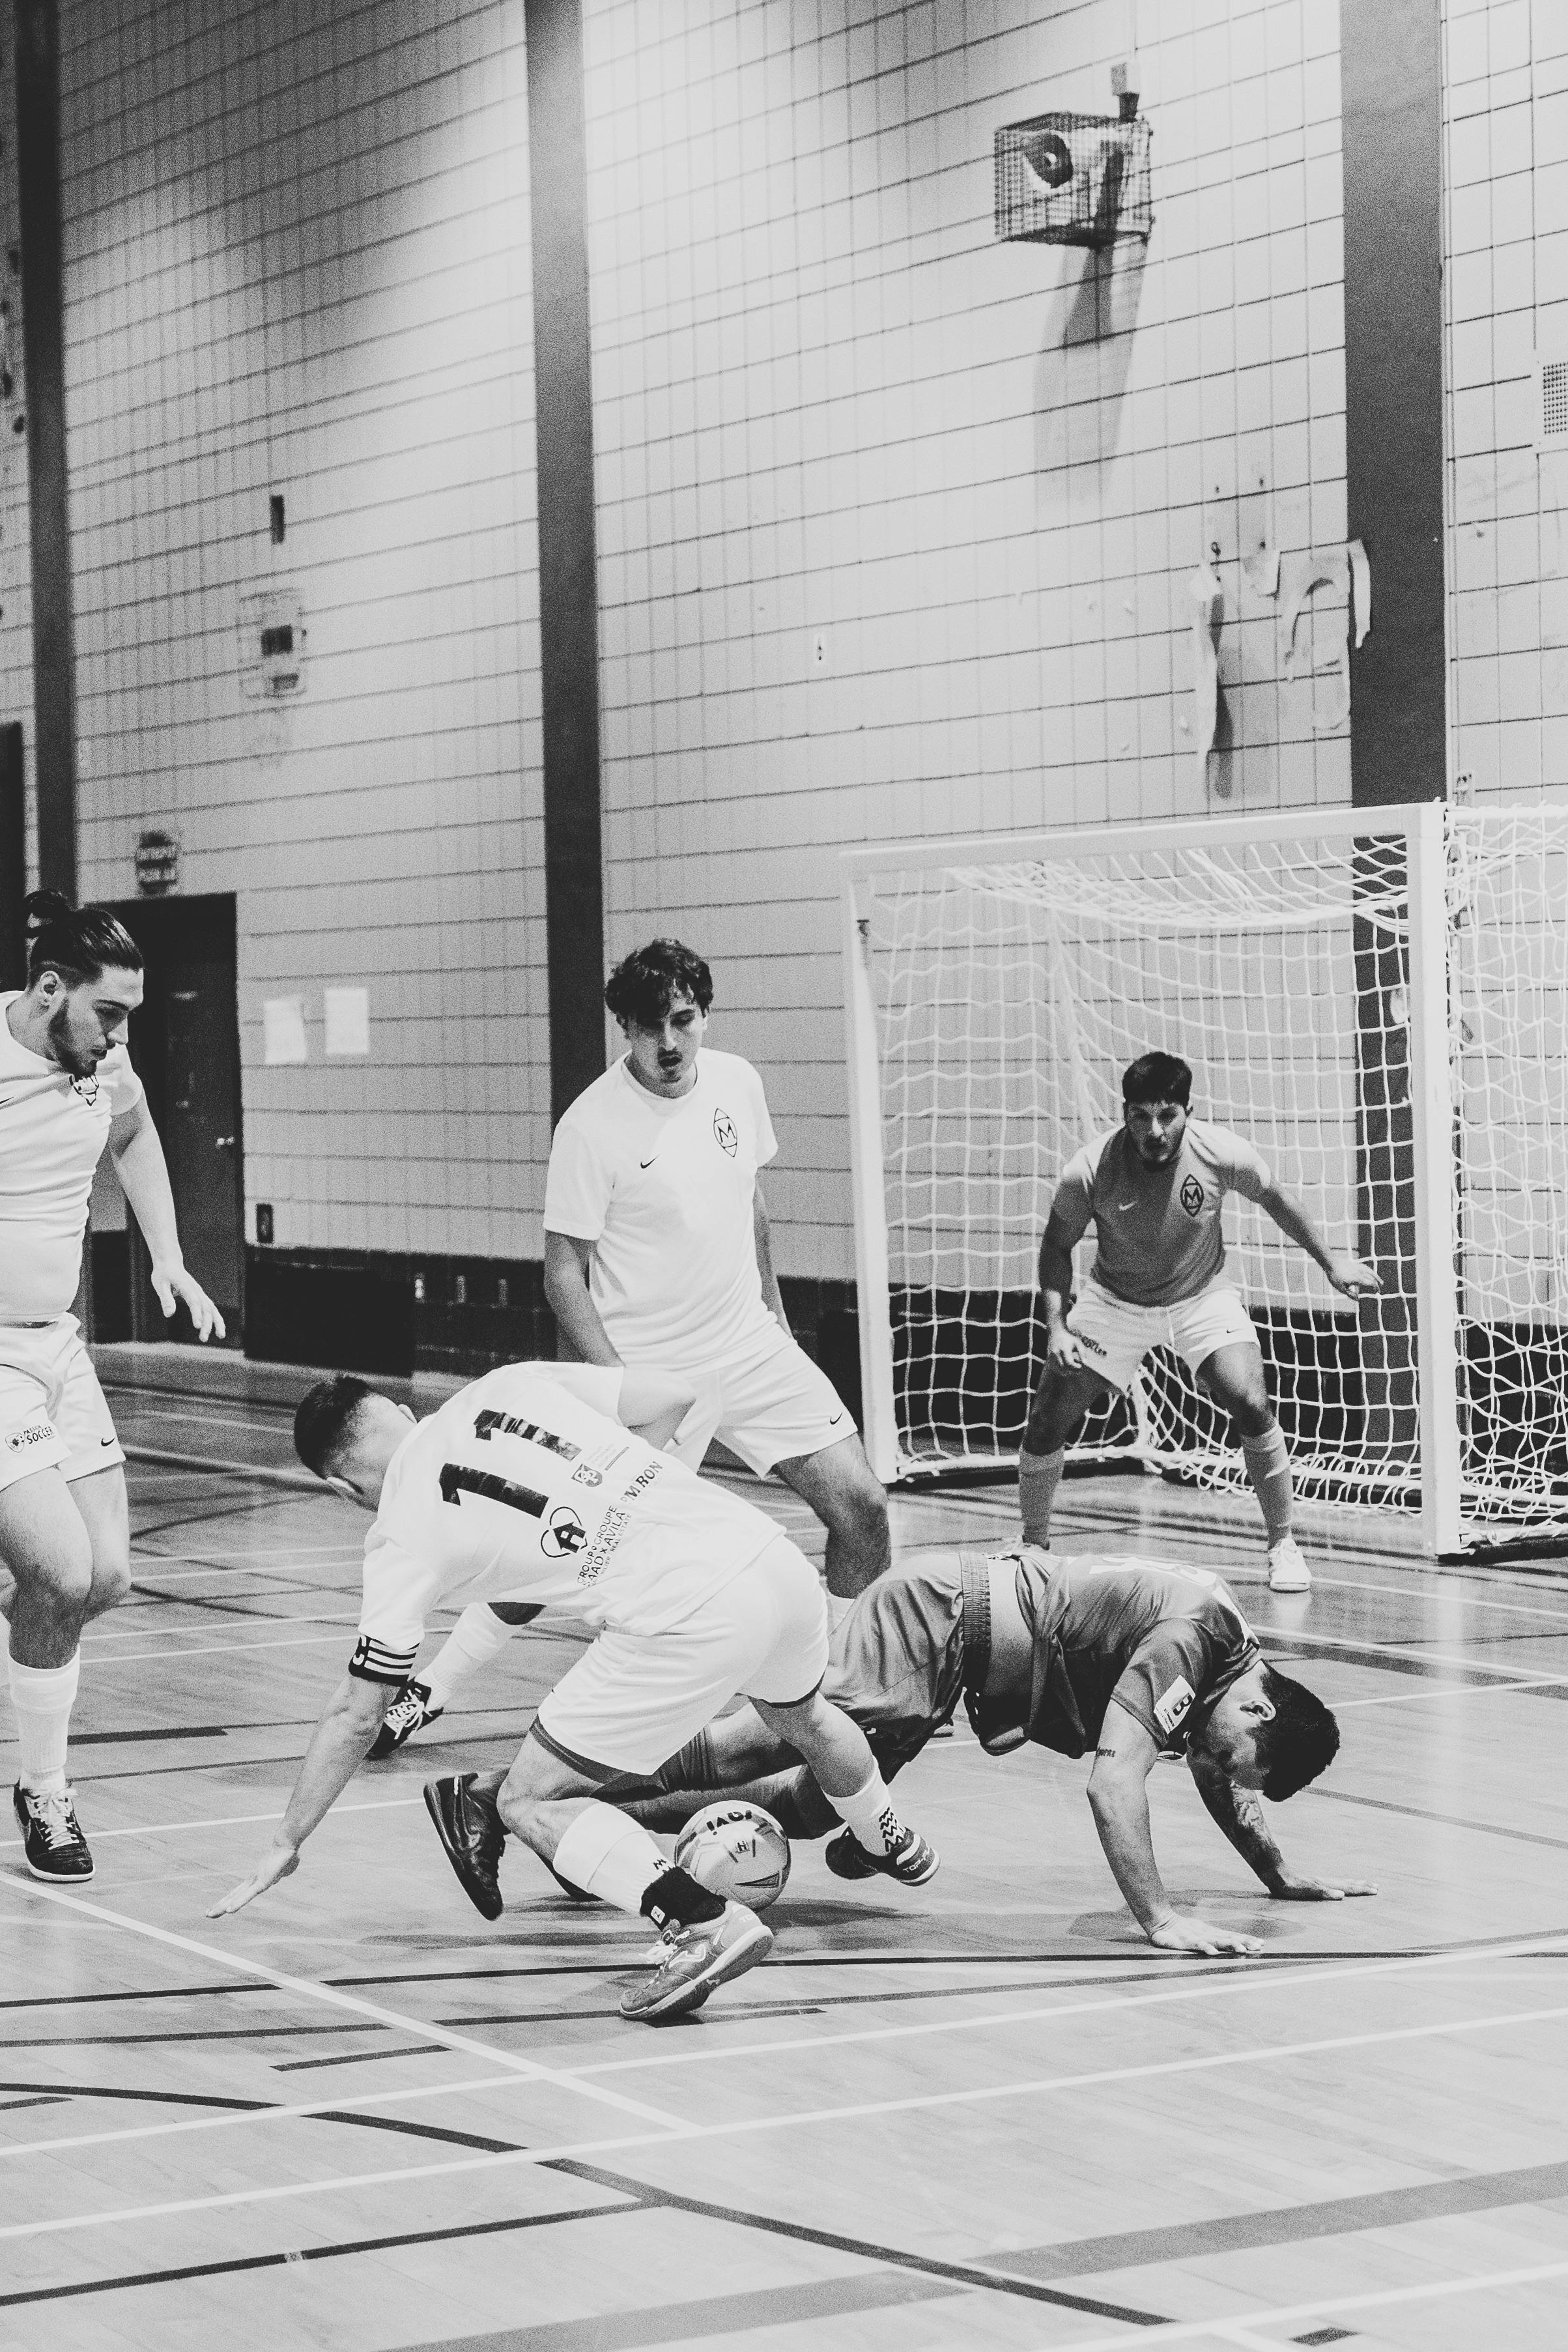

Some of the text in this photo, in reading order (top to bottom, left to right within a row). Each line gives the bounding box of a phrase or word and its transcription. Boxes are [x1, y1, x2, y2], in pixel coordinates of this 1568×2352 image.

[438, 1409, 582, 1519] 11
[593, 1505, 617, 1545] GROUPE
[603, 1511, 626, 1546] AVILA
